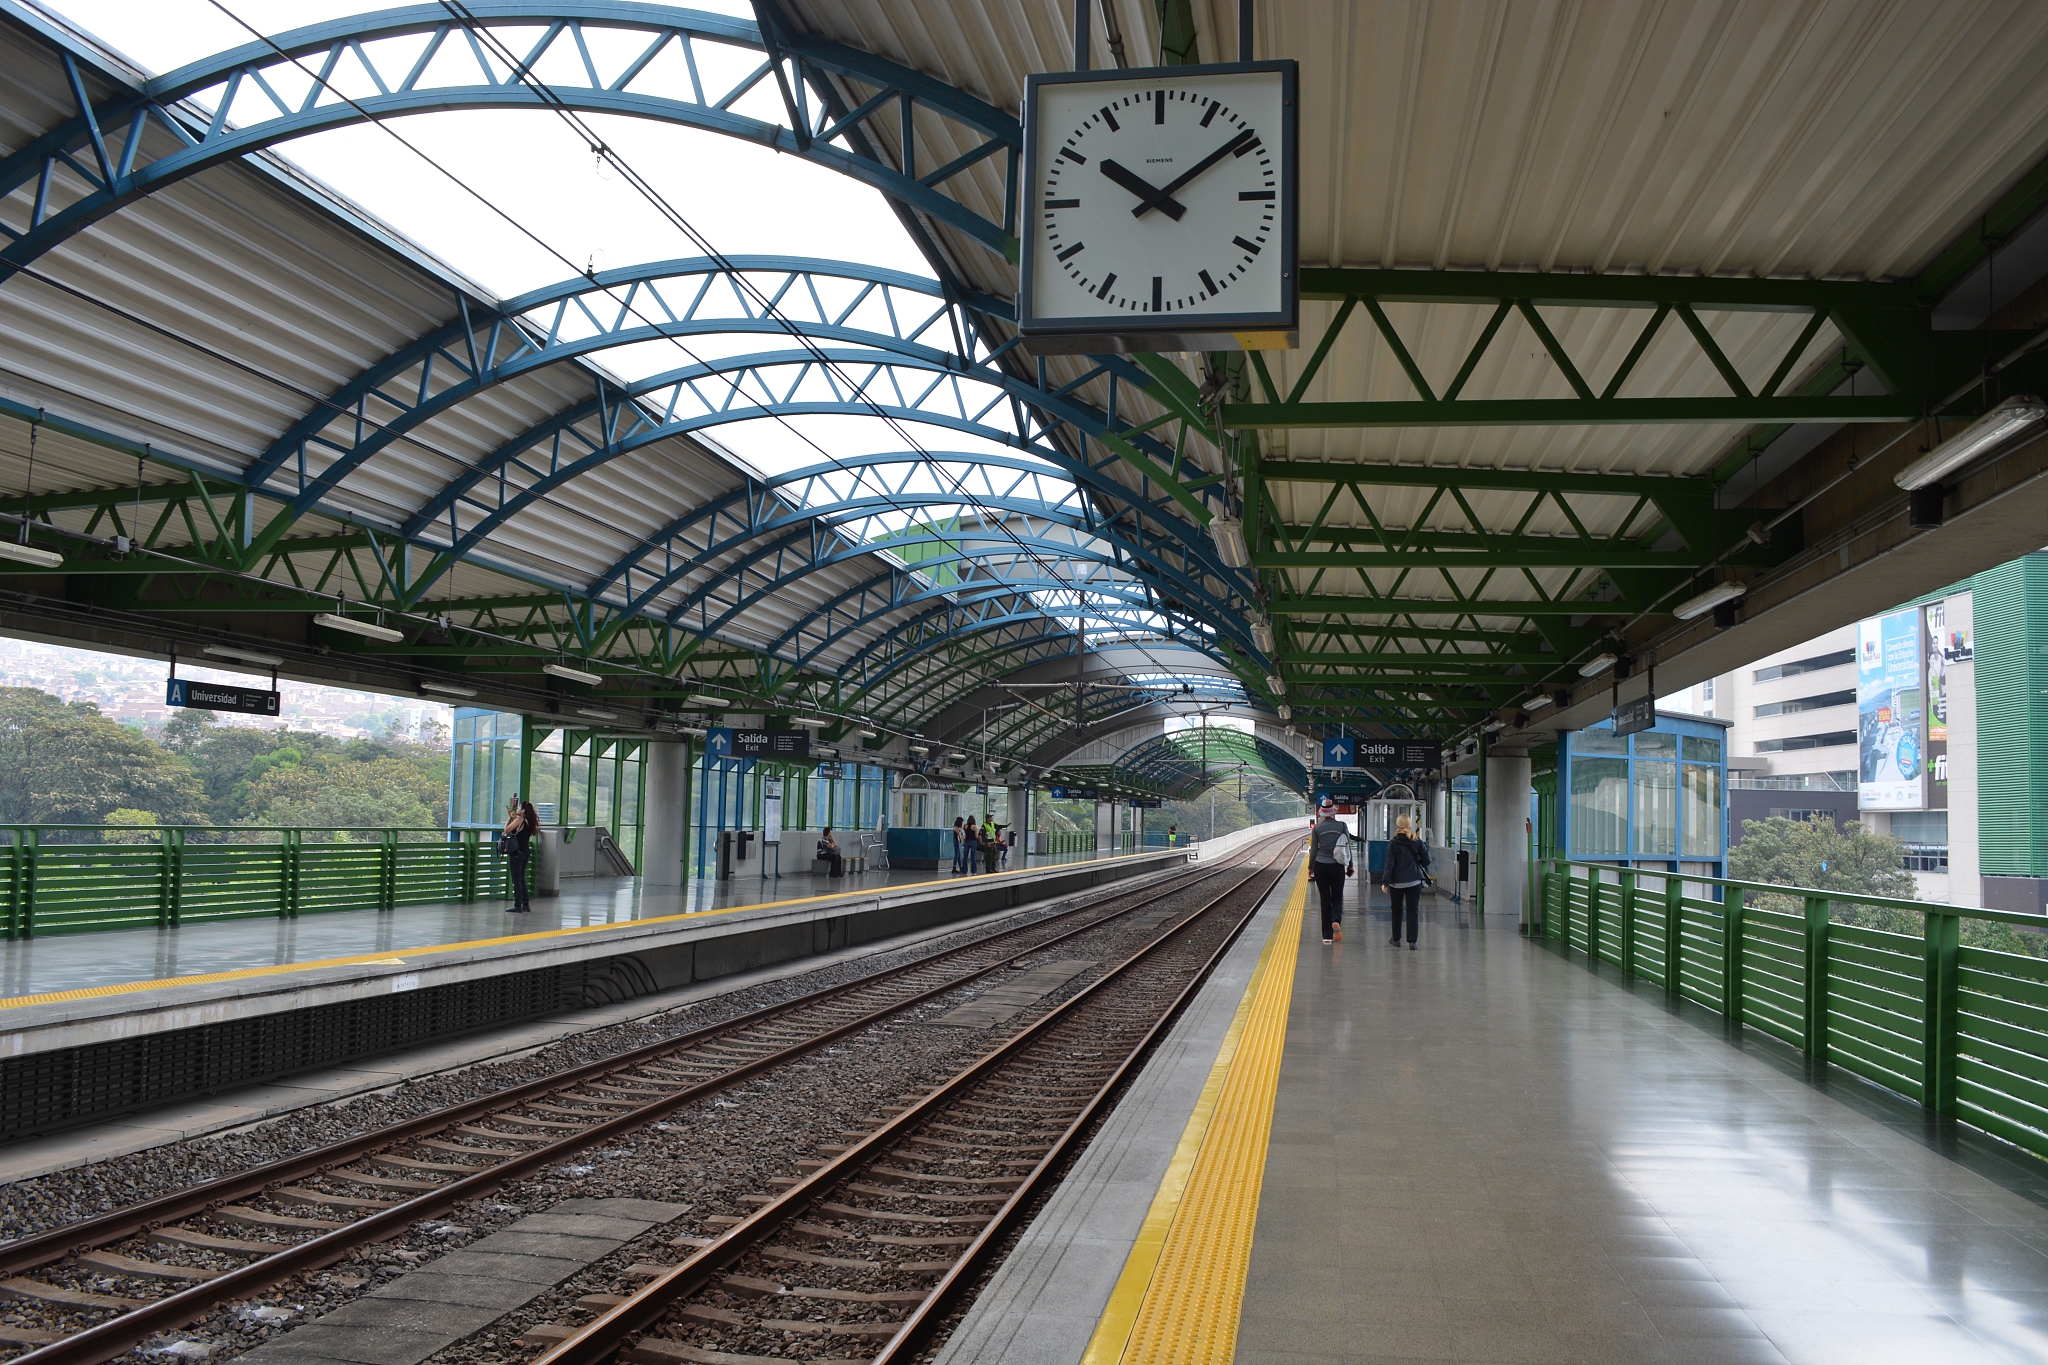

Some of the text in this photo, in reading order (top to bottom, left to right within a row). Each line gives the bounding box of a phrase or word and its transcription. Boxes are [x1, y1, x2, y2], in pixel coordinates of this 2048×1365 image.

[1887, 658, 1914, 673] Universidad
[171, 684, 182, 702] A
[191, 690, 237, 705] Universidad
[738, 733, 768, 744] Salida
[745, 744, 759, 752] Exit
[1360, 744, 1395, 755] Salida
[1369, 755, 1385, 763] Exit
